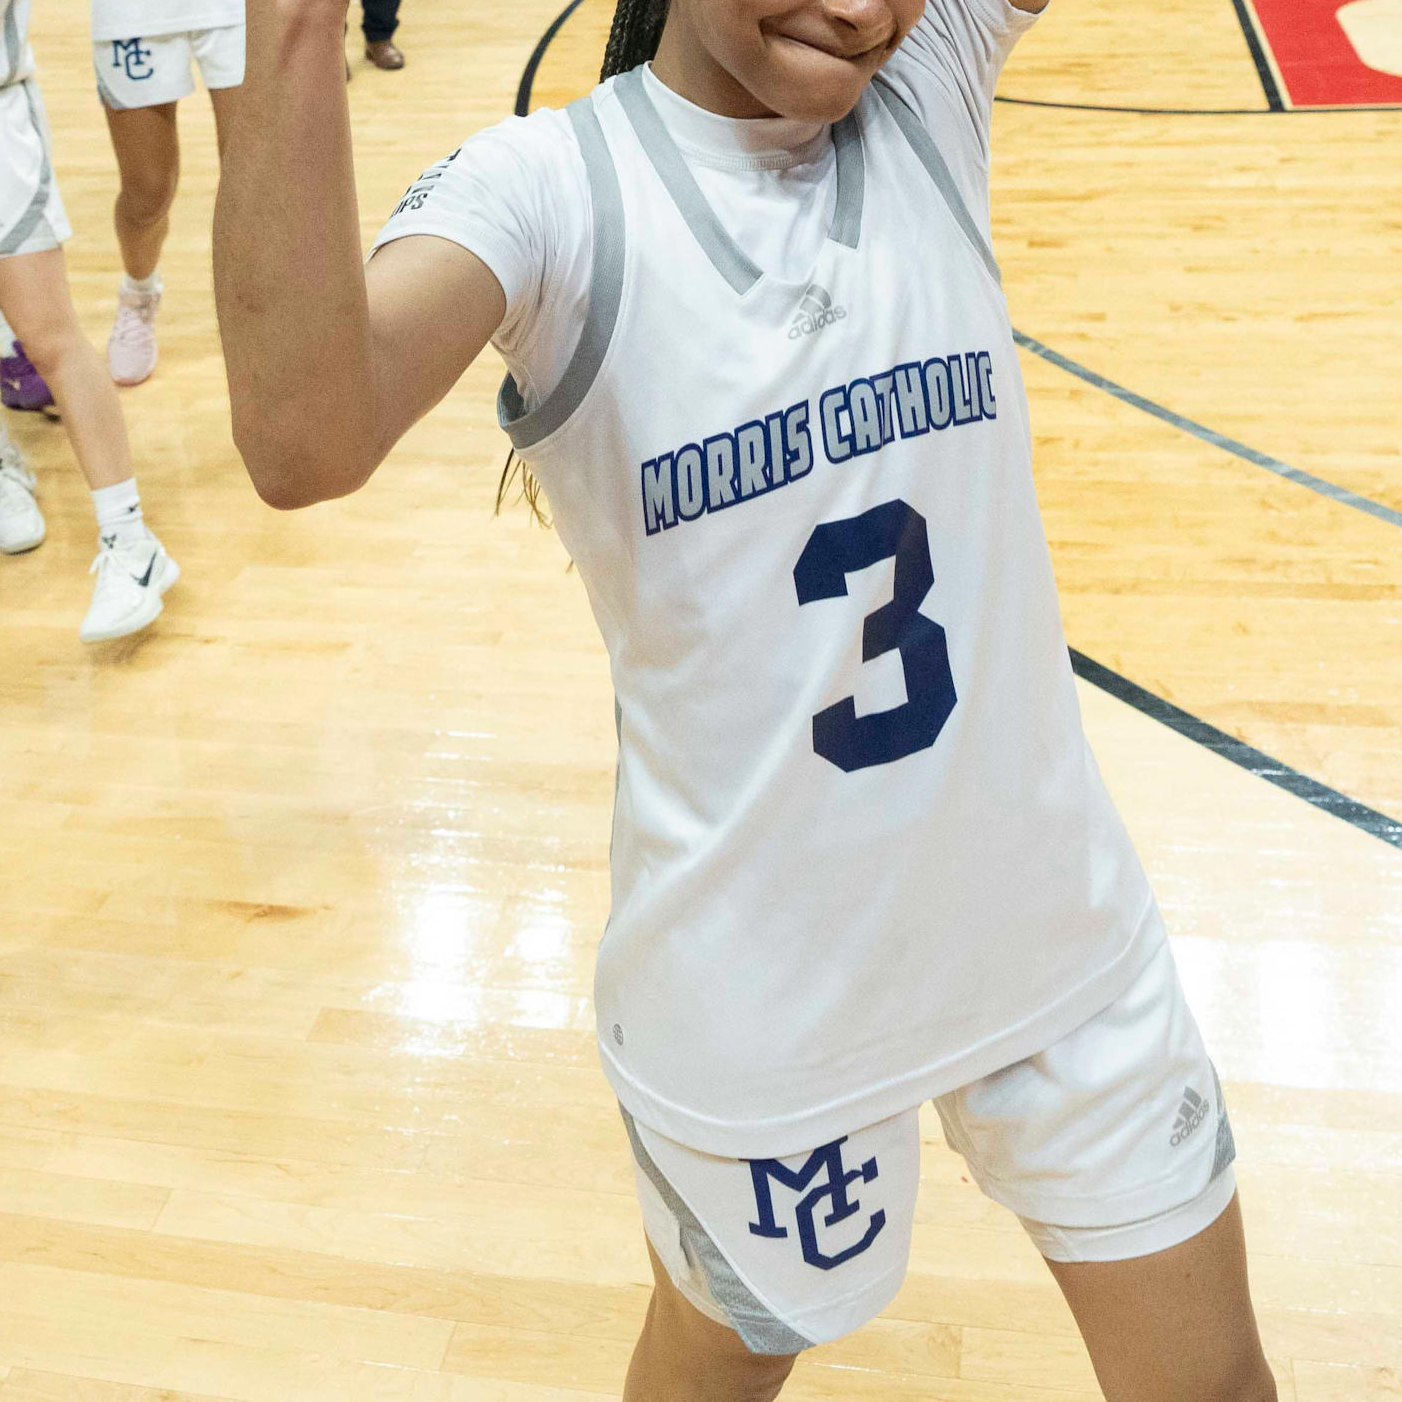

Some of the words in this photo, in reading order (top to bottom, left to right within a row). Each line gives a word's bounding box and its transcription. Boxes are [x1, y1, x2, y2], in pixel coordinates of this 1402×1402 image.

[787, 304, 848, 340] adidas
[640, 399, 812, 536] MORRIS
[819, 350, 997, 464] CATHOLIC
[792, 498, 958, 773] 3
[1169, 1098, 1211, 1147] adidas
[738, 1135, 887, 1270] MC
